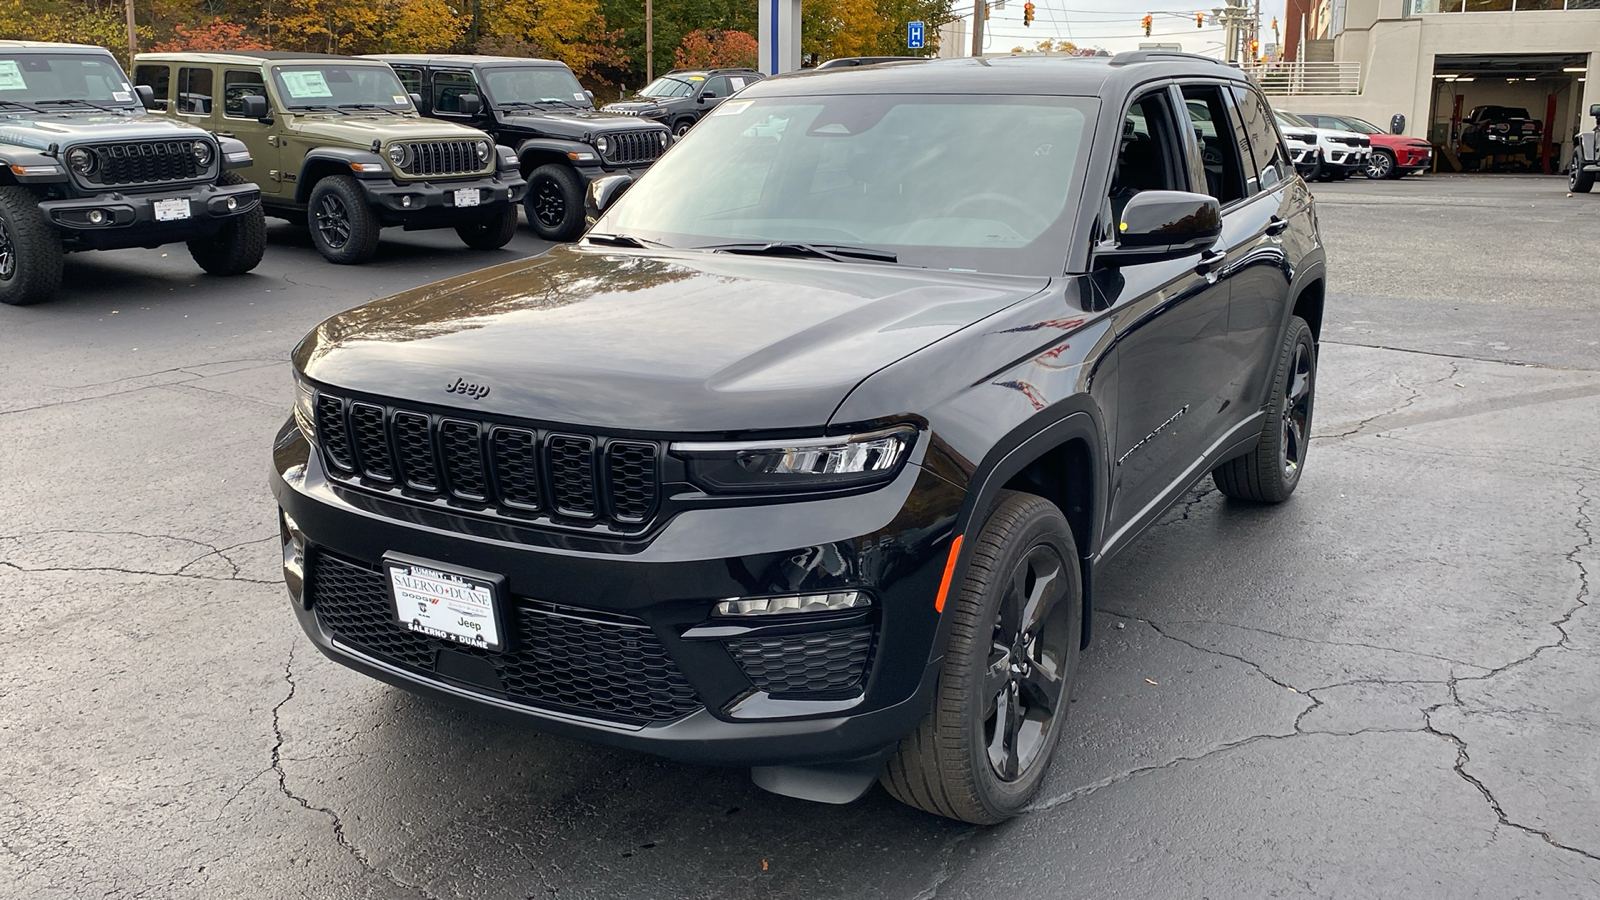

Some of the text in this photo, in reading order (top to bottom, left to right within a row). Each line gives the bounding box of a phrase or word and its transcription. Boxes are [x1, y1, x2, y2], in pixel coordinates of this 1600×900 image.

[911, 27, 921, 40] H
[445, 377, 491, 400] Jeep
[394, 575, 490, 606] SALERNO DUANE
[408, 622, 489, 649] SALERNO DUANE
[457, 617, 482, 632] Jeep
